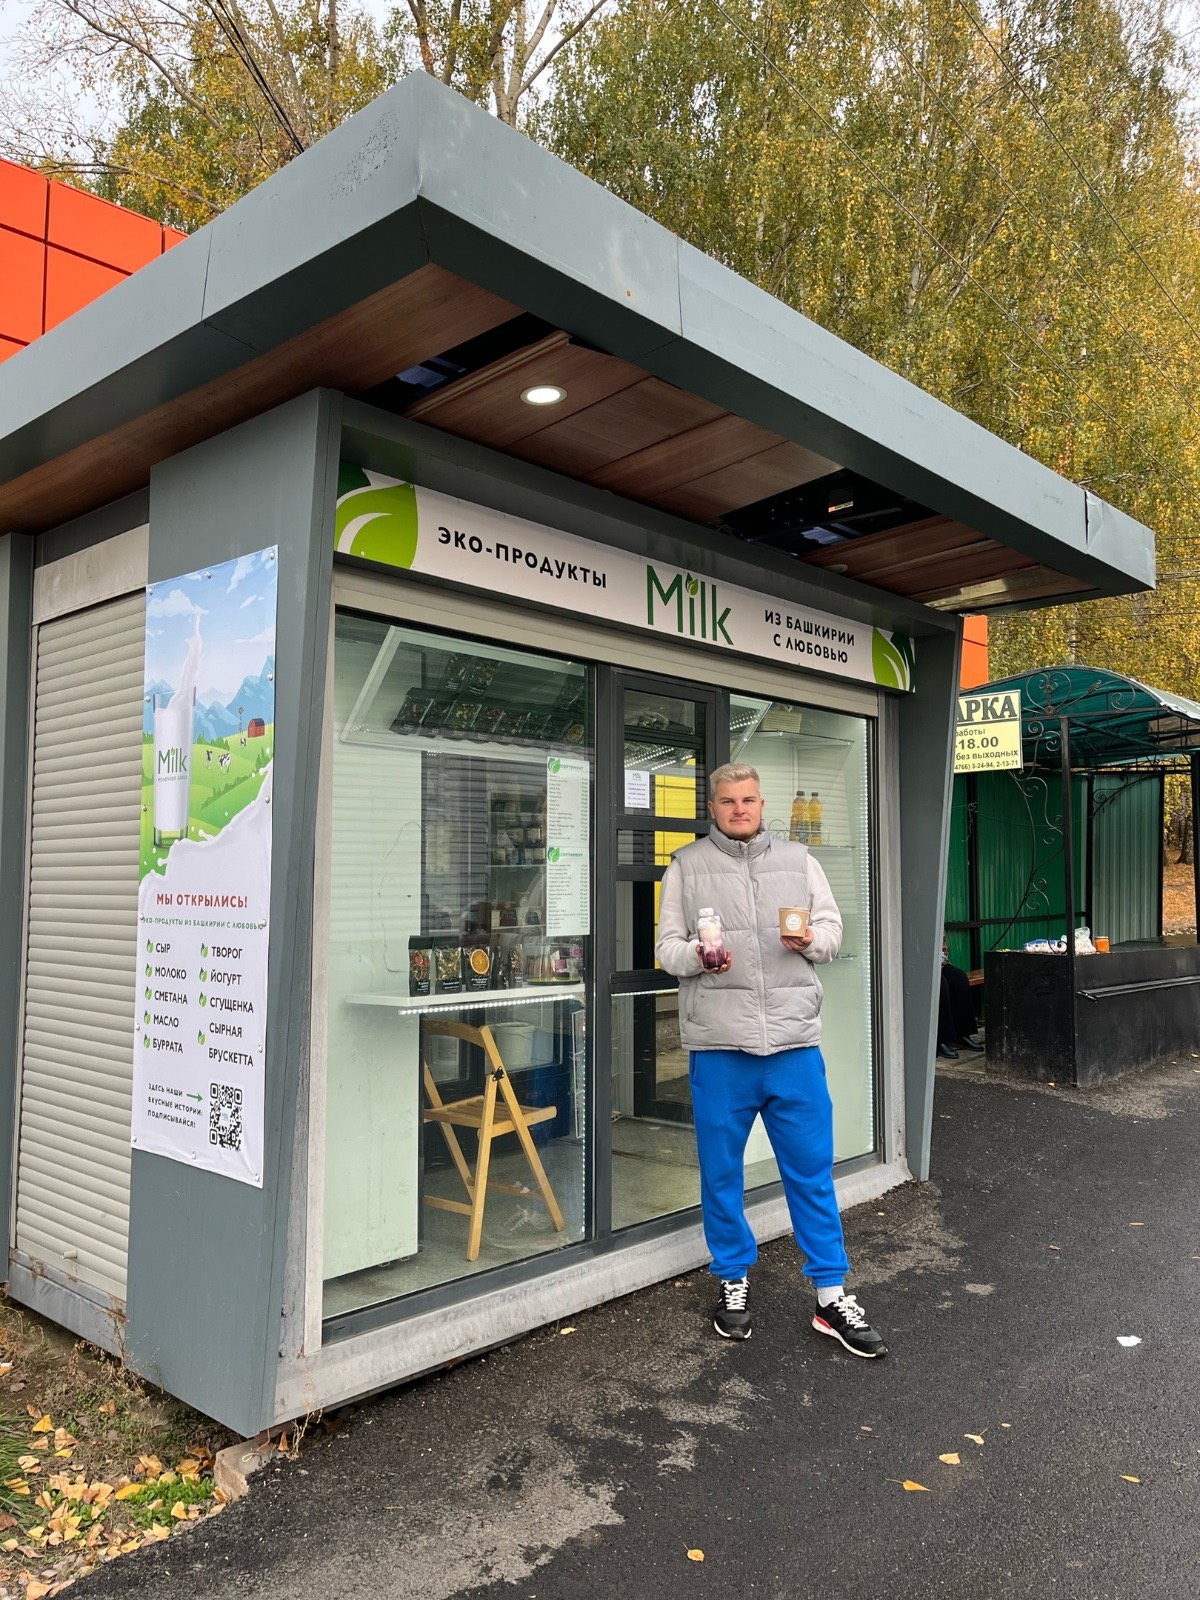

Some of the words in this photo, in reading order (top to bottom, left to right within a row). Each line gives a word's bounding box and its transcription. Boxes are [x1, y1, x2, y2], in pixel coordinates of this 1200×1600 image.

[438, 526, 607, 589] ЭКО-ПРОДУКТЫ
[646, 564, 734, 646] Milk
[764, 609, 781, 626] ИЗ
[786, 615, 855, 646] БАШКИРИИ
[773, 633, 781, 646] С
[785, 636, 848, 664] ЛЮБОВЬЮ
[158, 747, 188, 774] Milk
[956, 752, 970, 761] без
[972, 750, 1019, 759] выходных
[156, 893, 173, 905] МЫ
[176, 894, 248, 909] ОТКРЫЛИСЬ!
[226, 921, 231, 929] С
[232, 922, 263, 930] ЛЮБОВЬЮ
[155, 942, 171, 953] СЫР
[211, 946, 243, 959] ТВОРОГ
[155, 966, 187, 980] МОЛОКО
[210, 969, 242, 986] ЙОГУРТ
[154, 990, 188, 1005] СМЕТАНА
[209, 997, 254, 1013] СГУЩЕНКА
[153, 1014, 180, 1028] МАСЛО
[209, 1022, 242, 1038] СЫРНАЯ
[152, 1038, 184, 1053] БУРРАТА
[208, 1047, 254, 1067] БРУСКЕТТА
[148, 1083, 165, 1093] ЗДЕСЬ
[166, 1087, 183, 1097] НАШИ
[148, 1096, 173, 1108] ВКУСНЫЕ
[147, 1110, 196, 1128] ПОДПИСЫВАЙСЯ!
